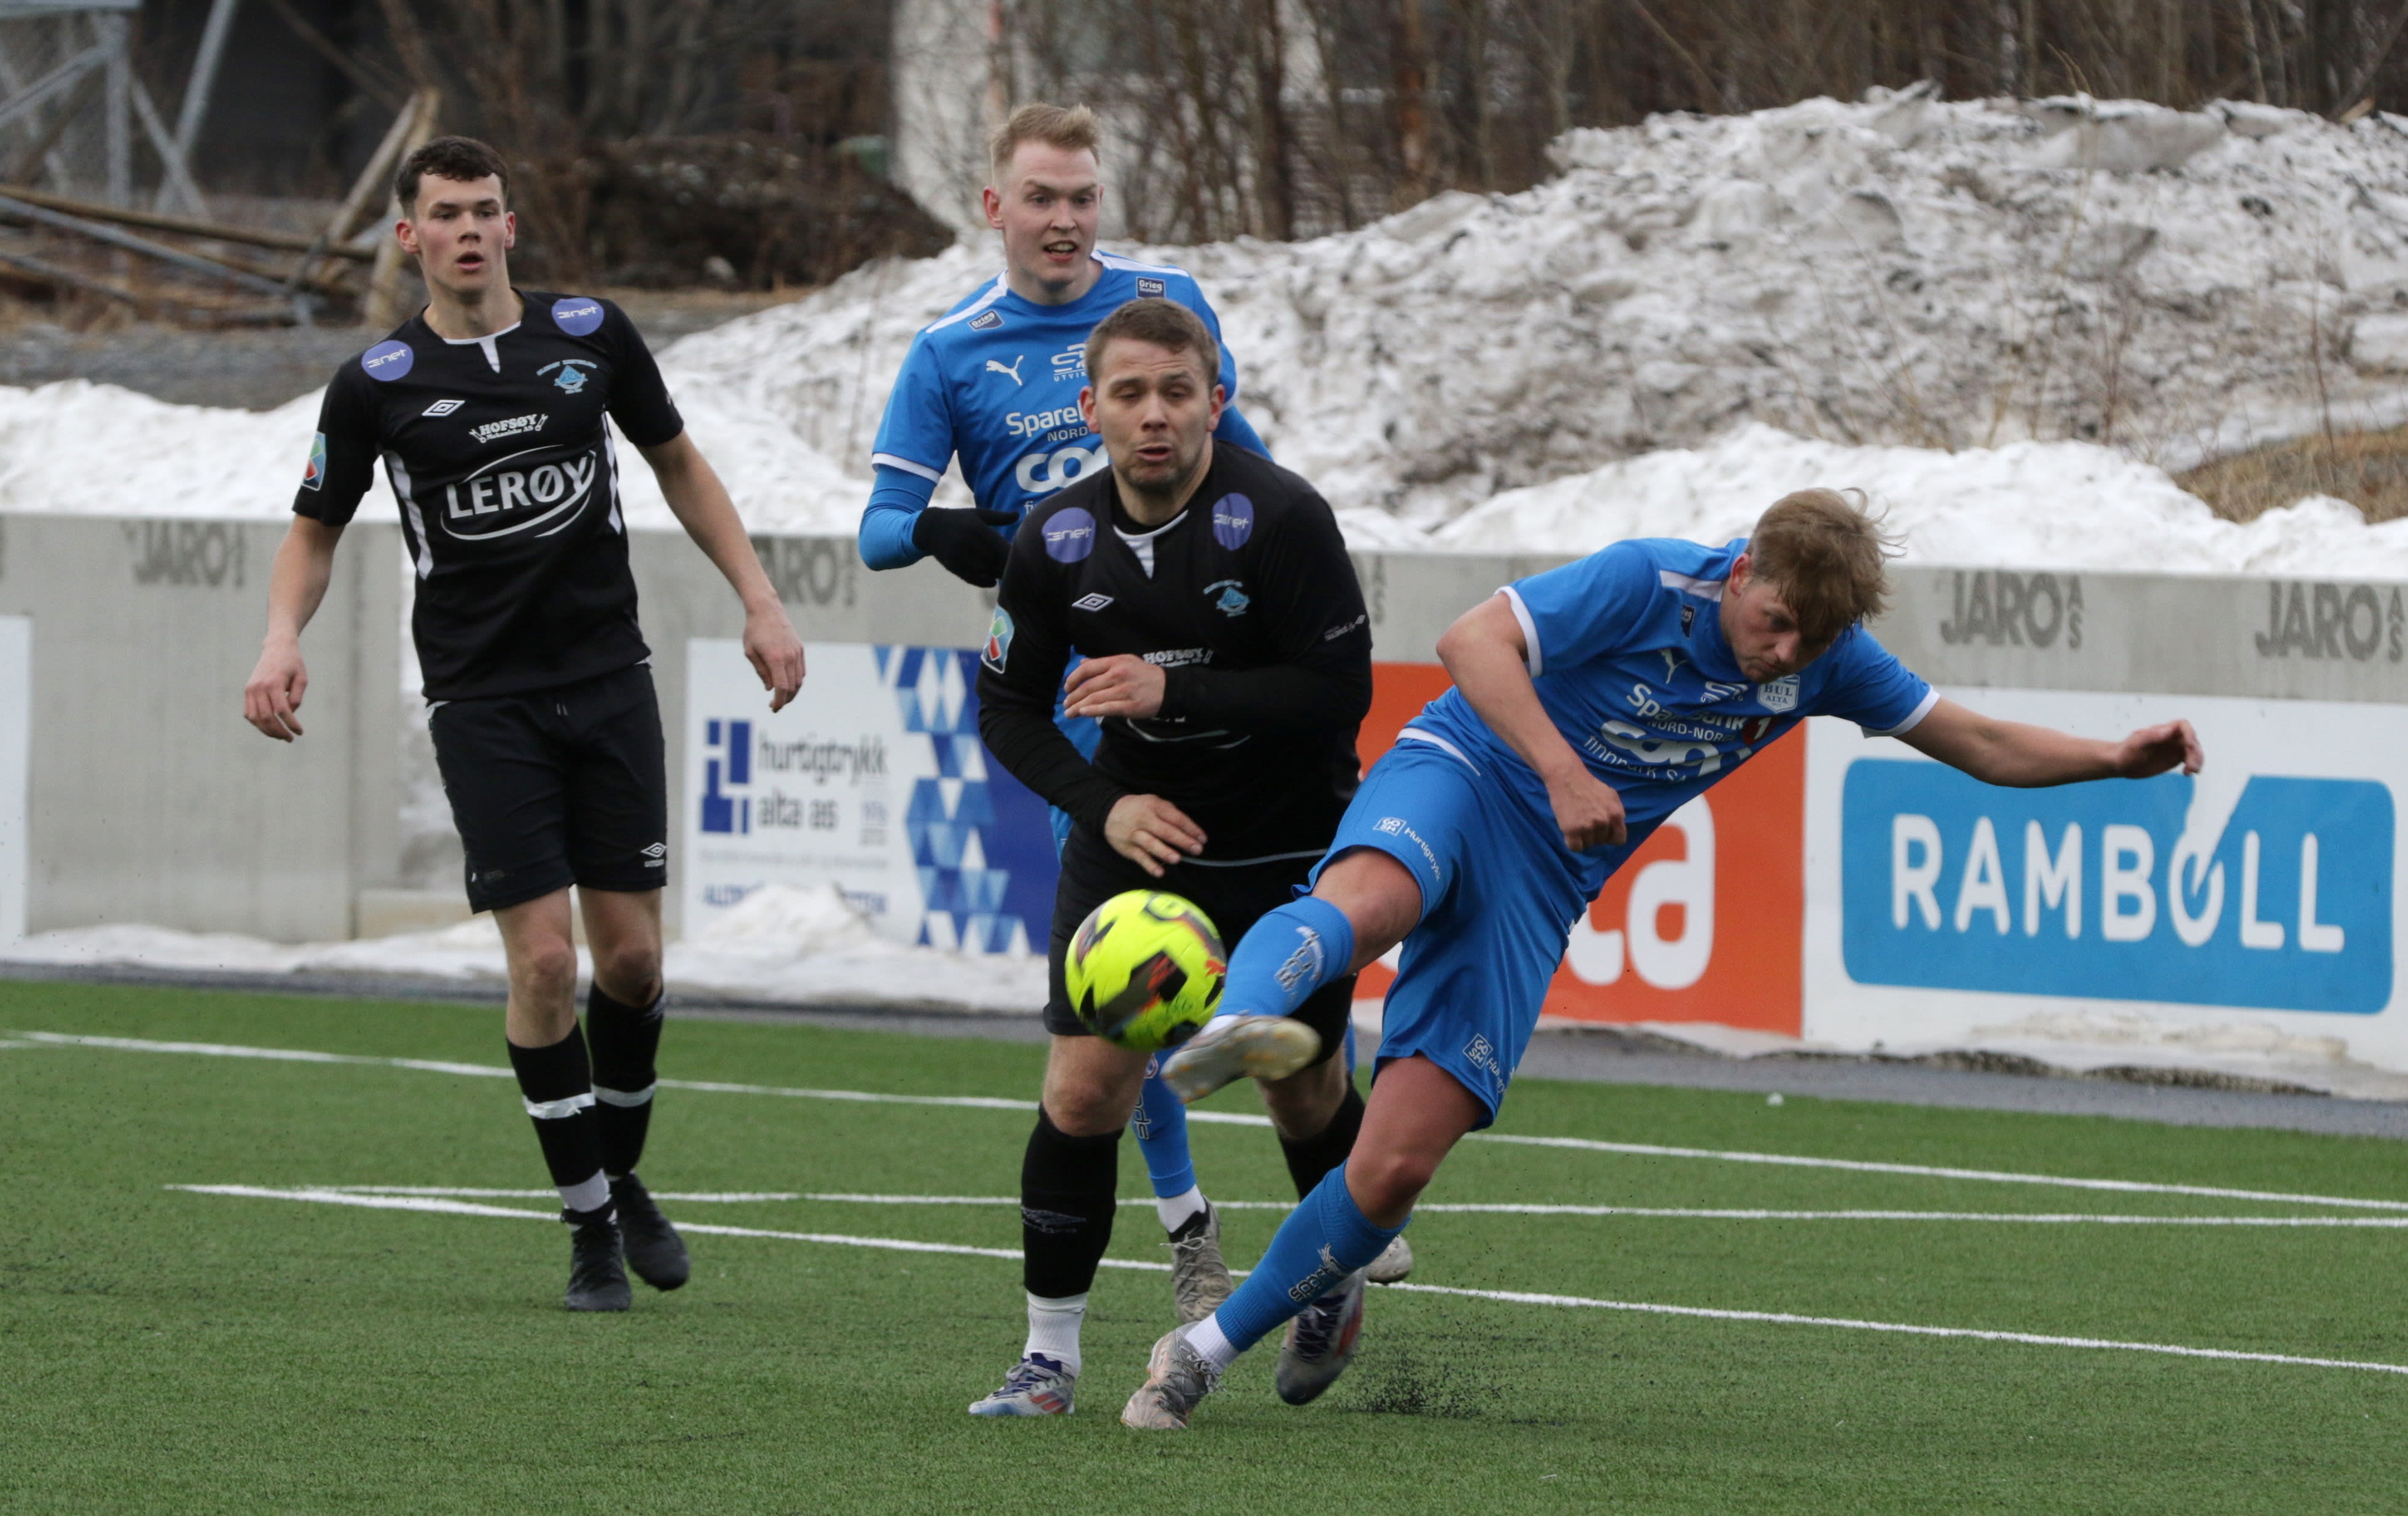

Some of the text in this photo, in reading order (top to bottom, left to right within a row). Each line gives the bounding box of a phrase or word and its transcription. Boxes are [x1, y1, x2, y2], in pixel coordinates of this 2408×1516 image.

[1139, 280, 1163, 292] Grieg
[479, 414, 537, 436] HOFSØY
[446, 457, 587, 519] LERØY
[1940, 571, 2063, 648] JARO
[2255, 581, 2383, 662] JARO
[1764, 683, 1793, 696] BUL
[1765, 695, 1787, 704] ALTA
[759, 733, 887, 785] hurtigtrykk
[758, 787, 802, 827] alta
[809, 798, 838, 828] as
